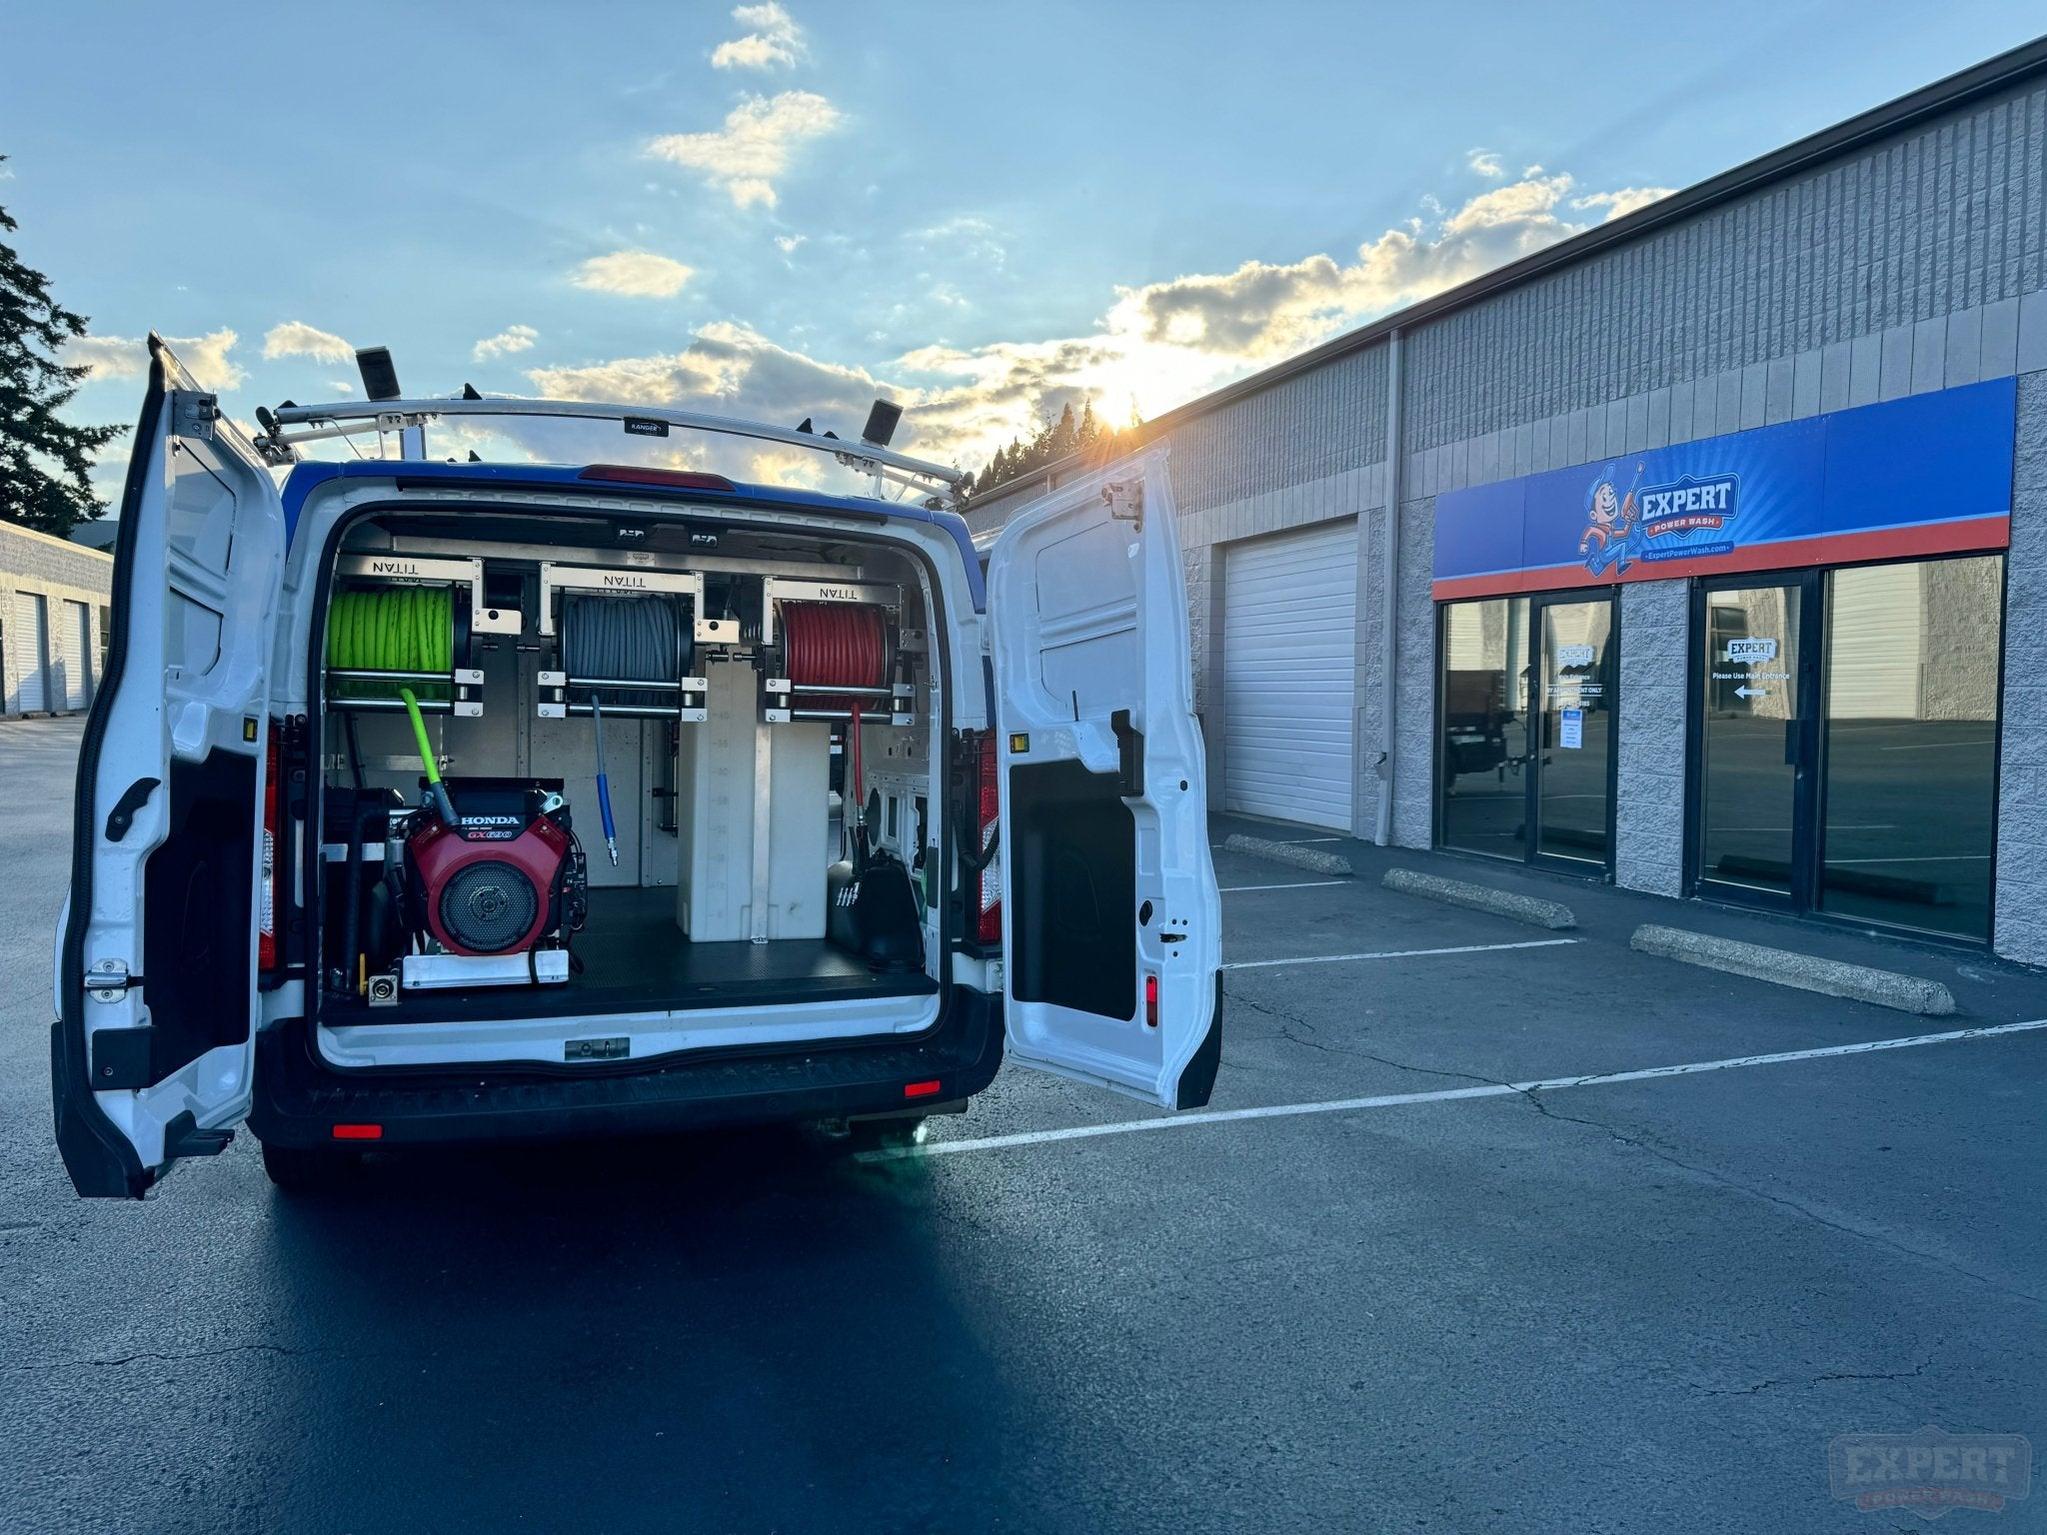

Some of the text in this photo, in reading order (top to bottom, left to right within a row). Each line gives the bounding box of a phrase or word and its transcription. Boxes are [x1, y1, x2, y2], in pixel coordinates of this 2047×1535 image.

[1642, 482, 1731, 521] EXPERT
[1654, 517, 1716, 533] POWER WASH
[1648, 544, 1727, 560] ExpertPowerWash.com
[373, 562, 419, 575] TITAN
[604, 576, 647, 588] TITAN
[819, 588, 858, 600] TITAN
[1731, 642, 1772, 655] EXPERT
[1712, 672, 1790, 680] Please Use Main Entrance
[461, 816, 520, 825] HONDA
